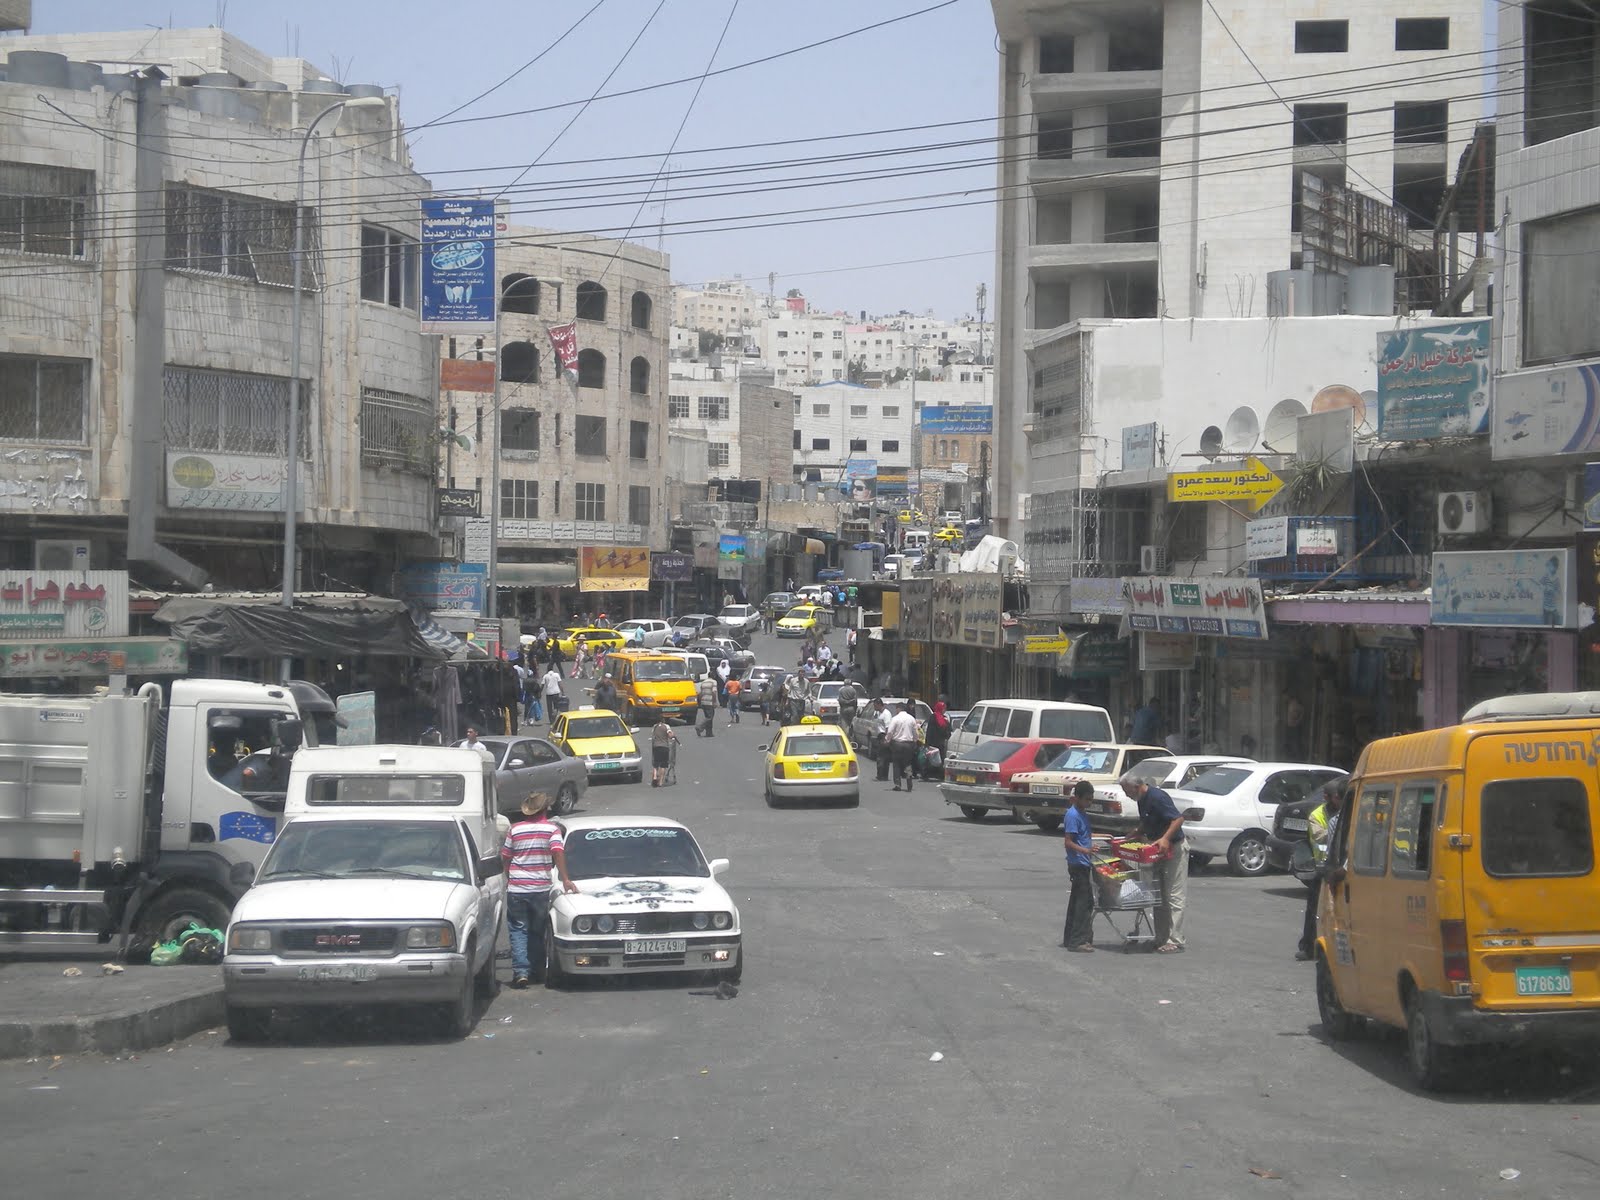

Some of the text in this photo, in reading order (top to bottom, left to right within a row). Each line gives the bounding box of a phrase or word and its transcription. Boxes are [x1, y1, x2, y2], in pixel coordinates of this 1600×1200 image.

[1380, 344, 1474, 376] شركة خليل الرحمن
[1177, 472, 1273, 489] الدكتور سعد عمرو
[440, 491, 481, 514] التميمي
[1, 576, 106, 607] مجوهرات
[1173, 584, 1198, 603] مجوهرات
[1503, 740, 1587, 763] החדשה
[315, 934, 361, 945] GMC
[1518, 975, 1571, 993] 6178630
